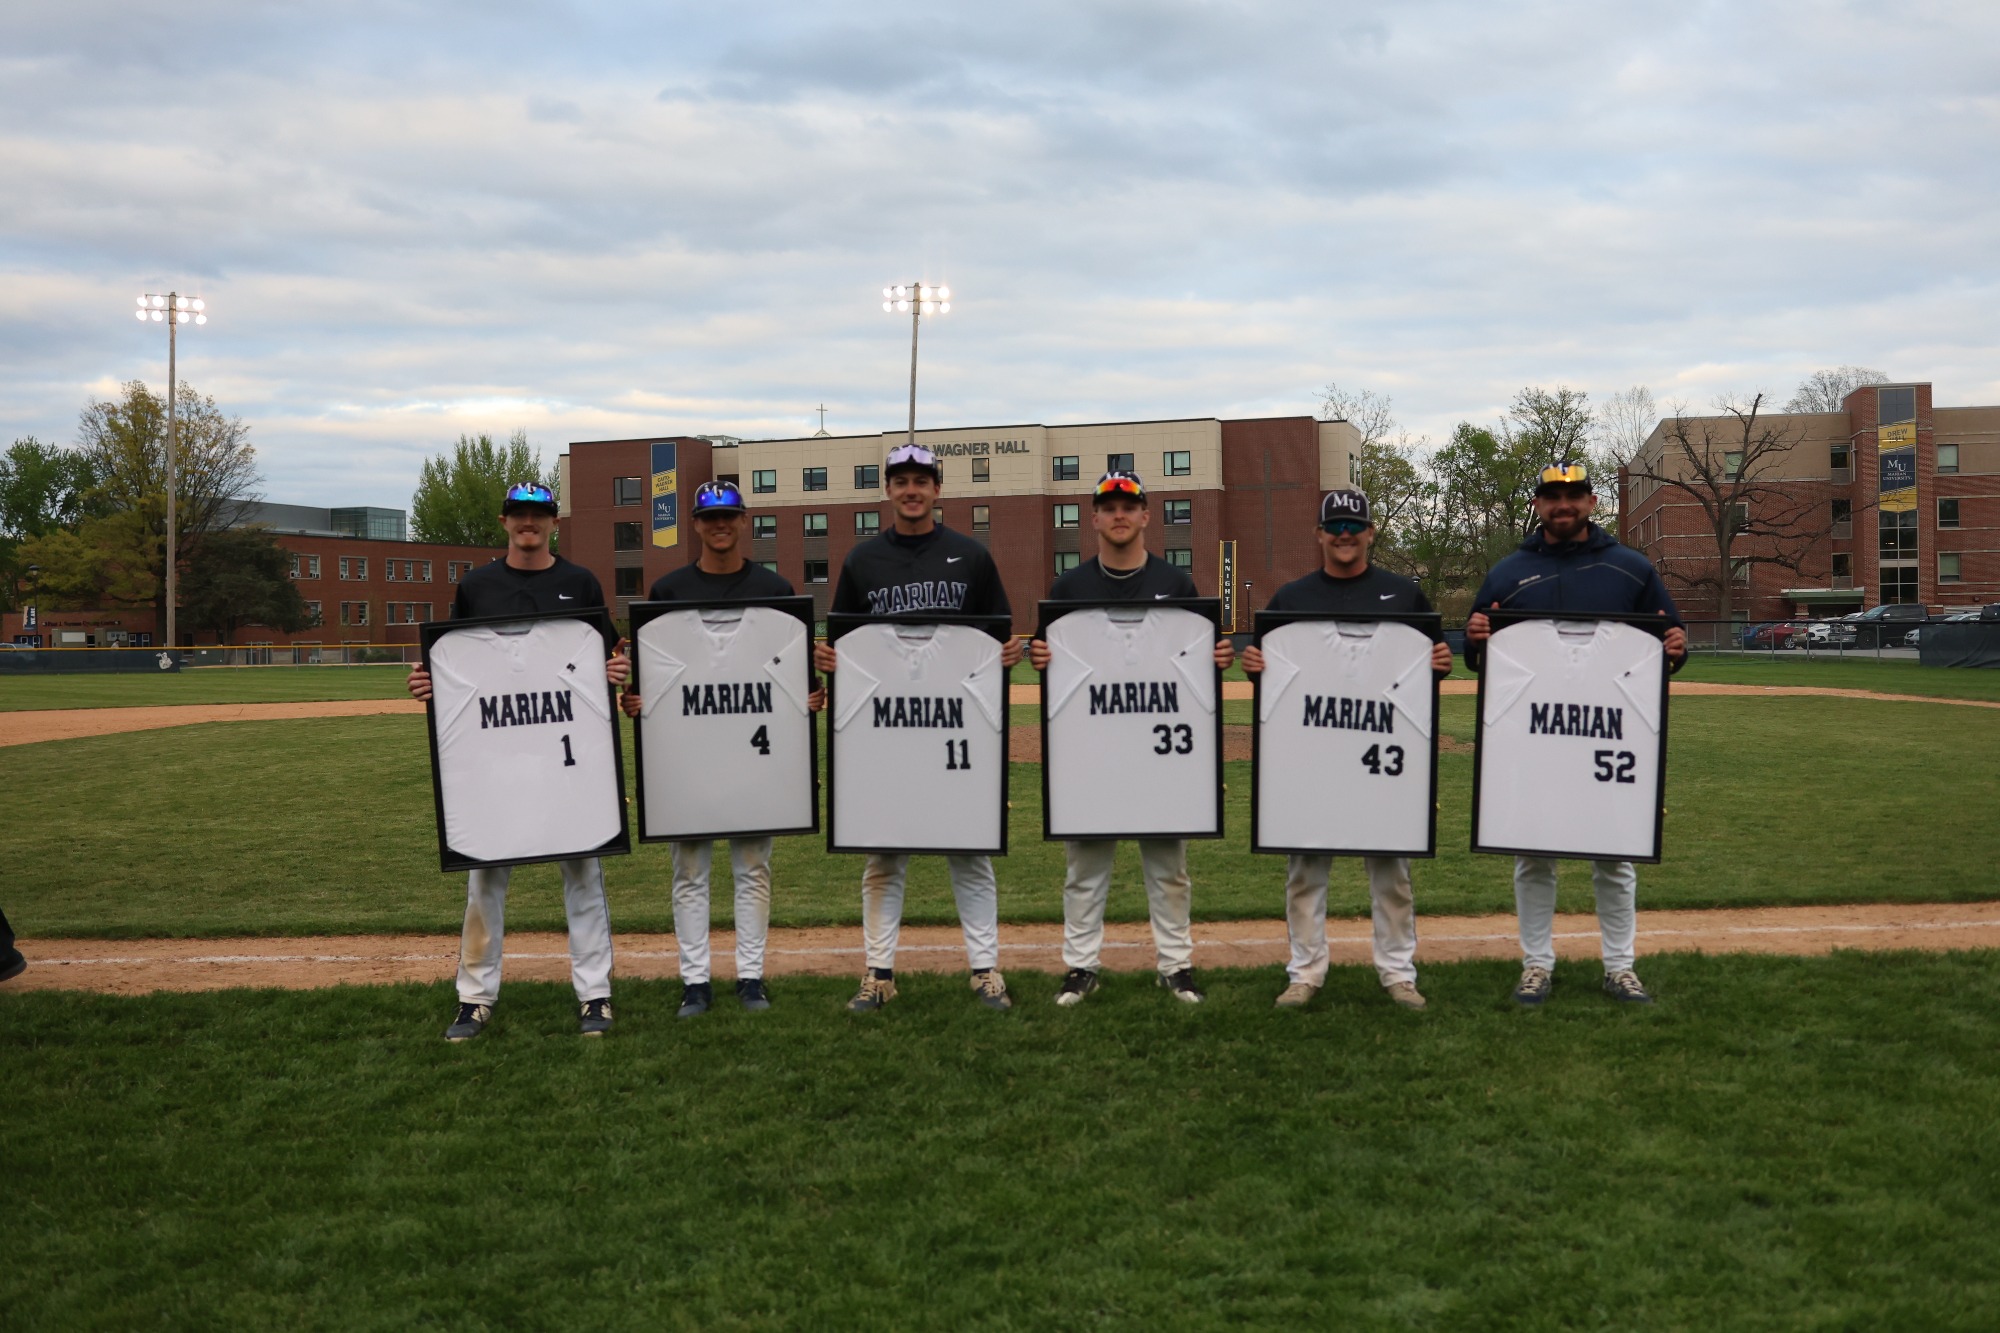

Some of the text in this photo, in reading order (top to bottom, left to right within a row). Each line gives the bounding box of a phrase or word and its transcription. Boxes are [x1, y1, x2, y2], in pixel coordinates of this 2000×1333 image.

[933, 442, 990, 457] WAGNER
[995, 440, 1030, 454] HALL
[1887, 428, 1908, 438] DREW
[1887, 459, 1907, 472] MU
[658, 503, 671, 513] MU
[1331, 492, 1361, 513] MU
[868, 580, 968, 615] MARIAN
[479, 690, 574, 730] MARIAN
[681, 681, 774, 717] MARIAN
[873, 696, 964, 729] MARIAN
[1089, 681, 1180, 715] MARIAN
[1303, 694, 1395, 734] MARIAN
[1529, 702, 1623, 740] MARIAN
[560, 734, 576, 767] 1
[750, 724, 771, 756] 4
[945, 738, 972, 770] 11
[1152, 723, 1194, 755] 33
[1361, 743, 1405, 776] 43
[1594, 749, 1636, 784] 52
